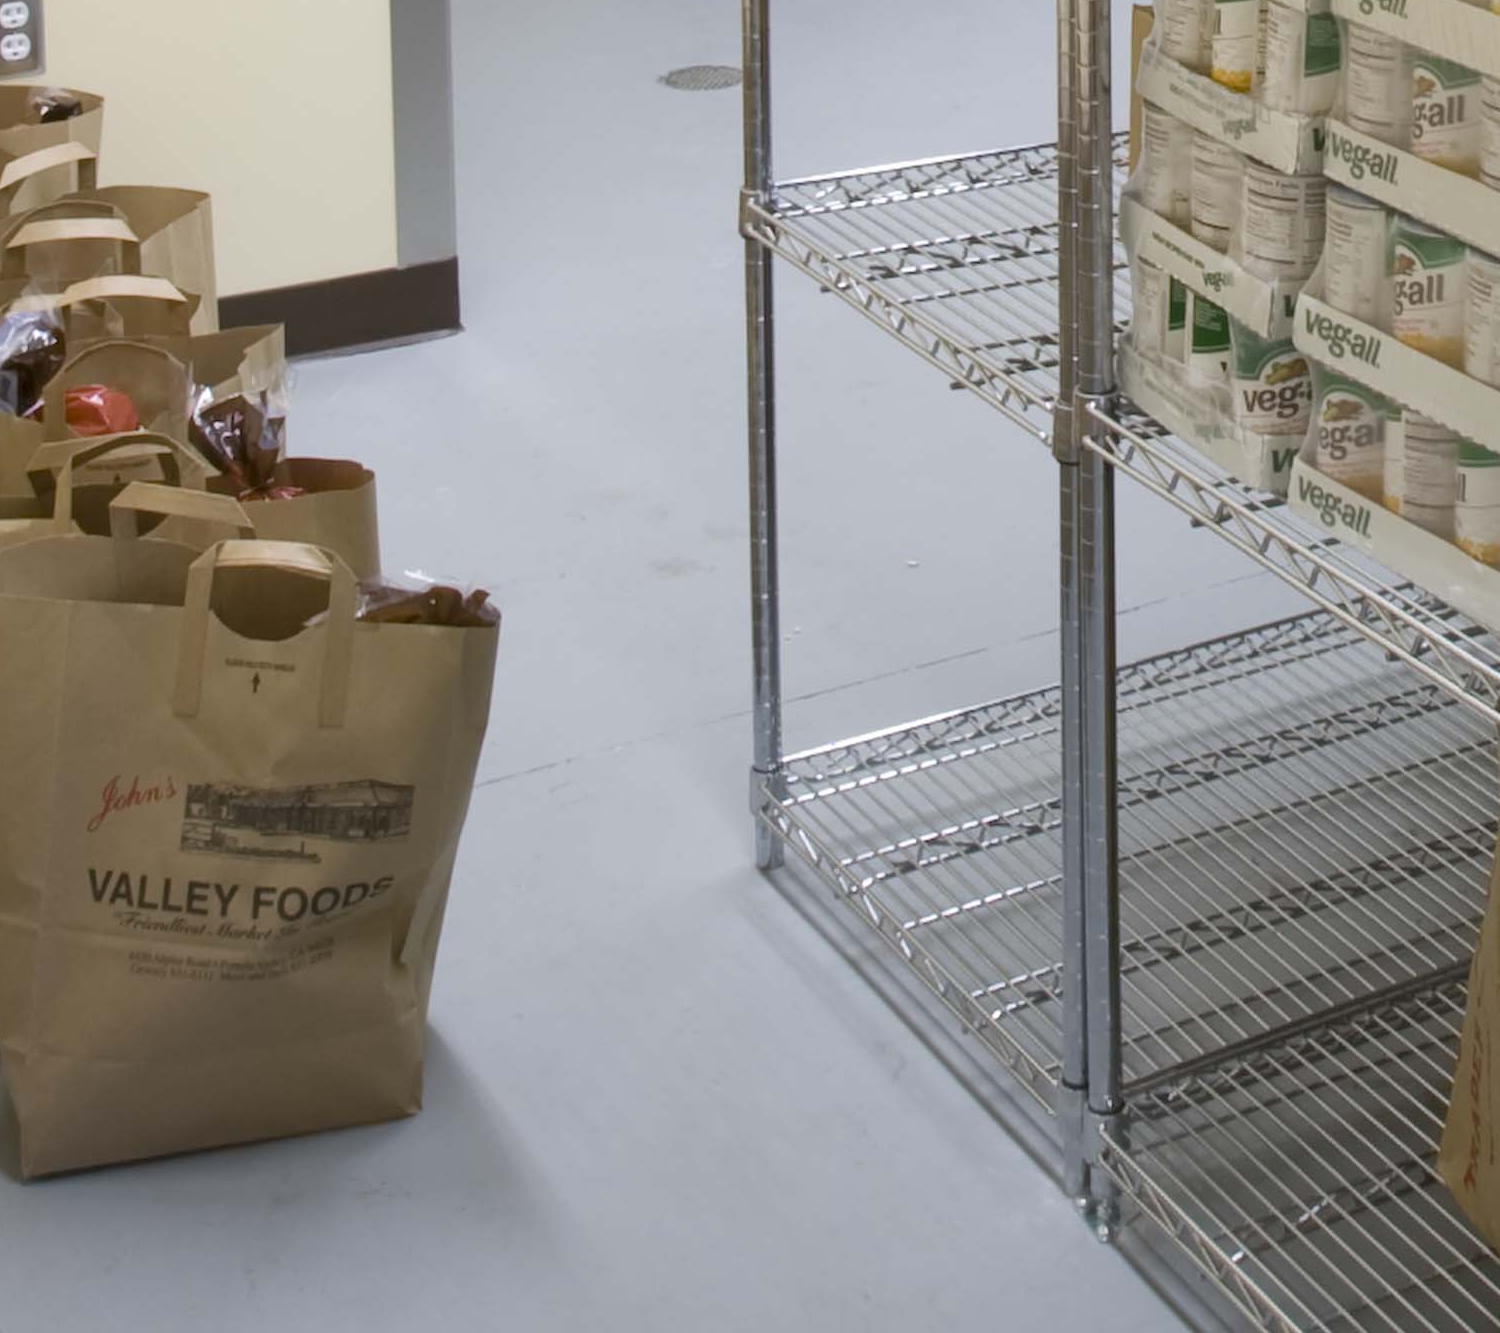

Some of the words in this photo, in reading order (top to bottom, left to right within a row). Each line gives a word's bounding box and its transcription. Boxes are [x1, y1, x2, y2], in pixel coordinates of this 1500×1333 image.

[86, 774, 179, 833] John's
[88, 868, 239, 918] VALLEY
[252, 876, 395, 922] FOODS
